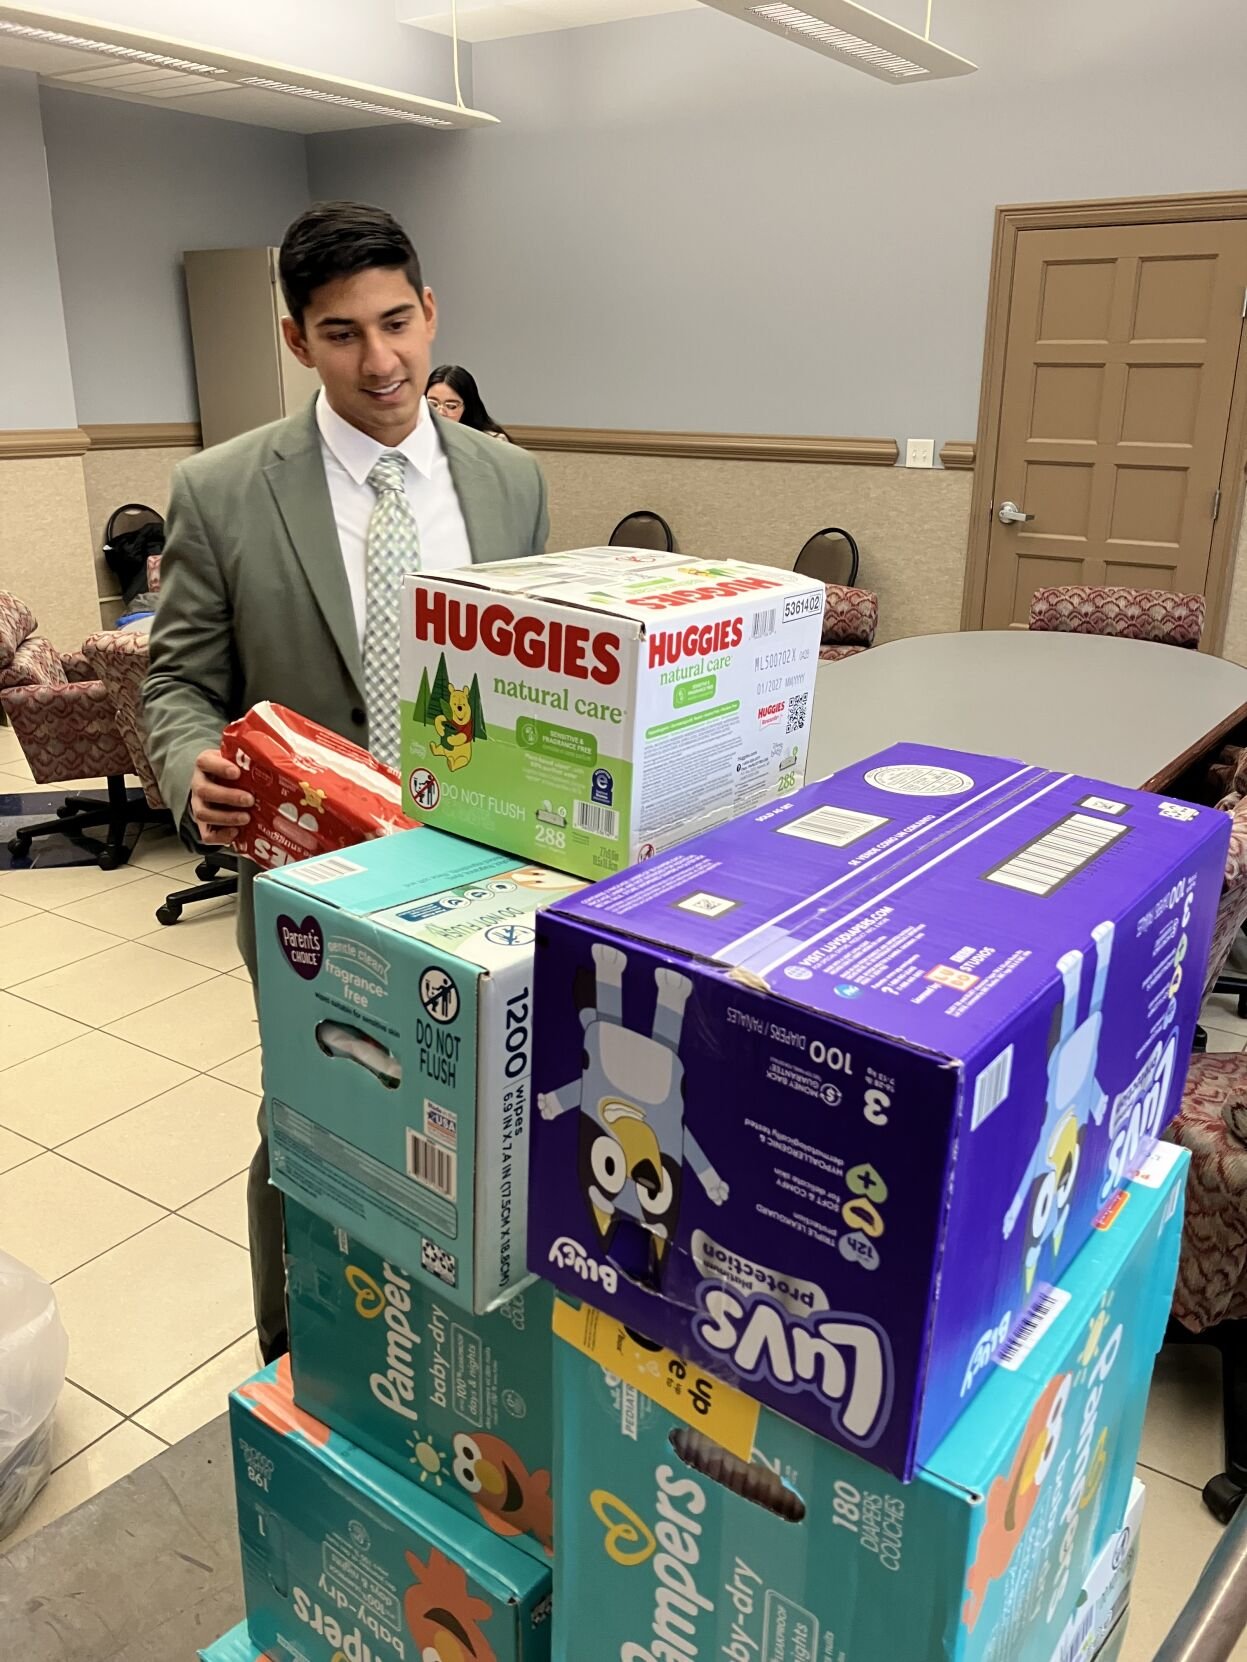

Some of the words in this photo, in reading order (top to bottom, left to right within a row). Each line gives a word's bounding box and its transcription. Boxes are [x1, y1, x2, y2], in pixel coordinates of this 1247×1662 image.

[625, 577, 783, 610] HUGGIES
[784, 595, 821, 617] 5361402
[415, 587, 621, 685] HUGGIES
[649, 617, 743, 668] HUGGIES
[660, 658, 704, 686] natural
[707, 655, 732, 676] care
[493, 677, 569, 712] natural
[575, 696, 623, 724] care
[758, 701, 785, 719] HUGGIES
[778, 771, 796, 792] 288
[442, 783, 458, 800] DO
[460, 787, 485, 808] NOT
[488, 796, 526, 822] FLUSH
[535, 824, 565, 849] 288
[1169, 877, 1186, 901] 100
[1182, 892, 1193, 928] 3
[283, 927, 320, 950] Parent's
[291, 950, 318, 966] CHOICE
[327, 940, 356, 957] gentle
[358, 949, 385, 974] clean
[799, 949, 826, 967] VISIT
[960, 947, 996, 973] STUDIOS
[325, 960, 388, 997] fragrance-
[343, 986, 368, 1008] free
[505, 986, 529, 1079] 1200
[726, 1006, 762, 1034] PAÑALES
[415, 1018, 433, 1048] DO
[436, 1028, 461, 1062] NOT
[770, 1024, 806, 1050] DIAPERS
[419, 1048, 456, 1089] FLUSH
[809, 1040, 852, 1075] 100
[765, 1070, 788, 1085] BACK
[769, 1064, 820, 1089] GUARANTEE
[789, 1081, 819, 1098] MONEY
[503, 1092, 513, 1112] 6.9
[514, 1084, 525, 1136] wipes
[863, 1088, 891, 1126] 3
[436, 1115, 457, 1132] USA
[503, 1114, 513, 1129] IN
[744, 1118, 771, 1135] tested
[502, 1131, 512, 1142] X
[771, 1128, 844, 1166] dermatologically
[767, 1137, 843, 1176] HYPOALLERGENIC
[501, 1164, 512, 1180] IN
[773, 1167, 791, 1180] skin
[776, 1178, 807, 1198] COMFY
[756, 1203, 806, 1230] LEAKGUARD
[816, 1196, 840, 1212] SOFT
[793, 1212, 838, 1236] protection
[808, 1226, 836, 1248] TRIPLE
[846, 1236, 874, 1259] 12h
[701, 1239, 815, 1308] protection
[702, 1259, 754, 1291] platinum
[513, 1293, 524, 1330] COUC
[370, 1262, 421, 1421] Pamper
[427, 1303, 451, 1408] baby-dry
[467, 1344, 479, 1378] nights
[701, 1290, 883, 1437] Luvs
[468, 1393, 477, 1416] days
[687, 1378, 713, 1415] up
[247, 1466, 269, 1492] 198
[831, 1479, 862, 1534] 180
[258, 1514, 266, 1536] 1
[860, 1491, 882, 1554] DIAPERS
[879, 1495, 905, 1572] COUCHES
[318, 1573, 405, 1660] baby-dry
[721, 1556, 763, 1662] by-dry
[293, 1586, 384, 1662] pers
